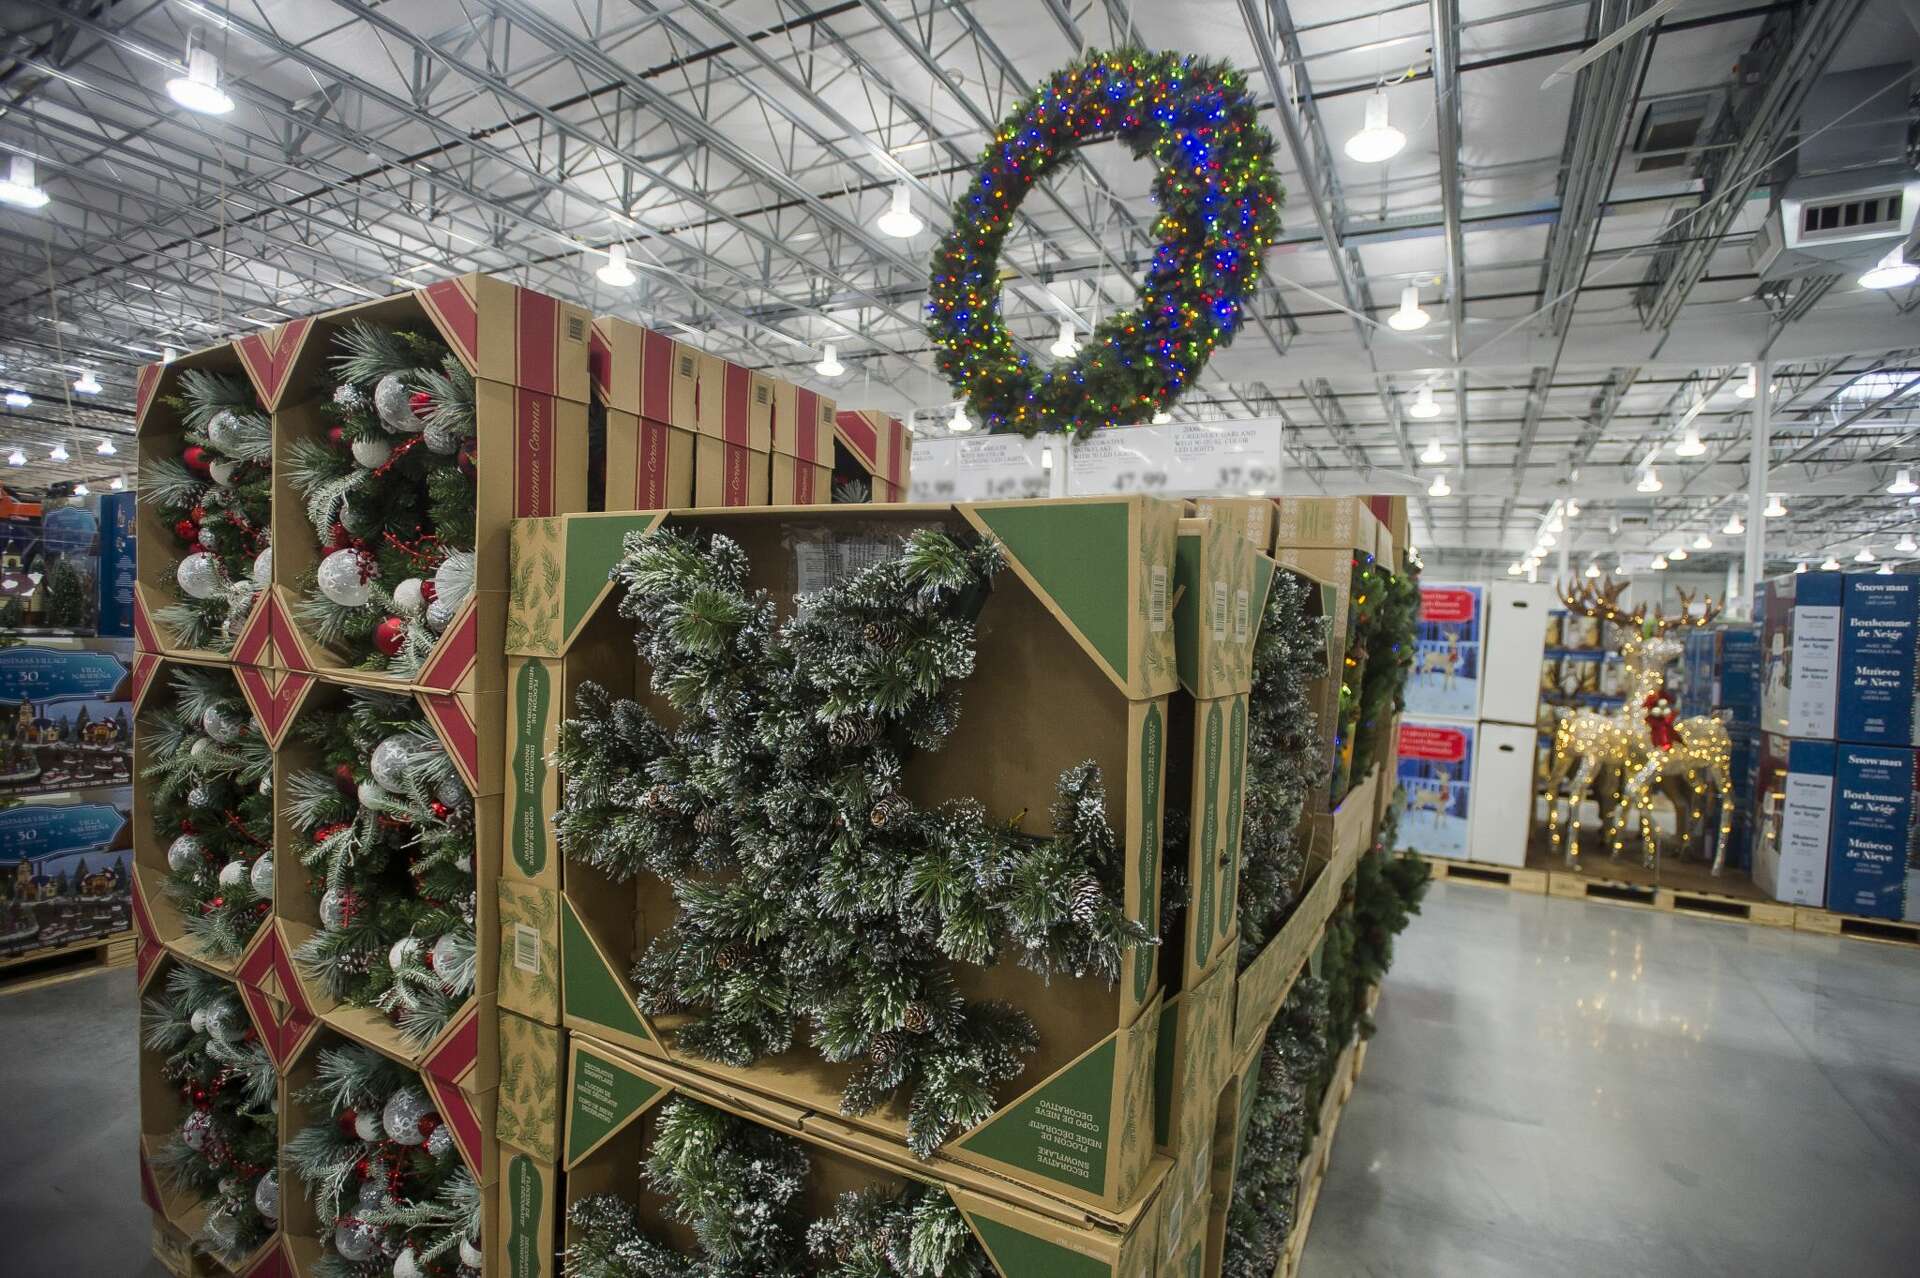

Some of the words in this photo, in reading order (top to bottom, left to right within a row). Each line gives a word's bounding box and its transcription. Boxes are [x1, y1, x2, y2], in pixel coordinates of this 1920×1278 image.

[528, 400, 541, 452] Corona
[647, 428, 658, 473] Corona
[1855, 582, 1909, 592] Snowman
[1850, 617, 1911, 628] Bonhomme
[1857, 629, 1871, 638] de
[1872, 629, 1903, 640] Neige
[1856, 666, 1900, 676] Muñeco
[1854, 677, 1868, 686] de
[1870, 677, 1900, 687] Nieve
[531, 679, 539, 712] FLOCON
[531, 713, 537, 724] DE
[1848, 754, 1902, 767] Snowman
[1843, 789, 1904, 803] Bonhomme
[1850, 801, 1864, 810] de
[1866, 802, 1897, 816] Neige
[1849, 837, 1893, 851] Muñeco
[1846, 849, 1860, 858] de
[1862, 850, 1893, 862] Nieve
[1034, 1106, 1061, 1120] NIEVE
[1040, 1100, 1093, 1121] DECORATIVO
[1062, 1114, 1074, 1124] DE
[1076, 1119, 1099, 1132] COPO
[1041, 1131, 1052, 1141] DE
[1075, 1134, 1102, 1149] NEIGE
[1054, 1137, 1088, 1153] FLOCON
[1038, 1146, 1090, 1170] SNOWFLAKE
[1037, 1154, 1089, 1178] DECORATIVE
